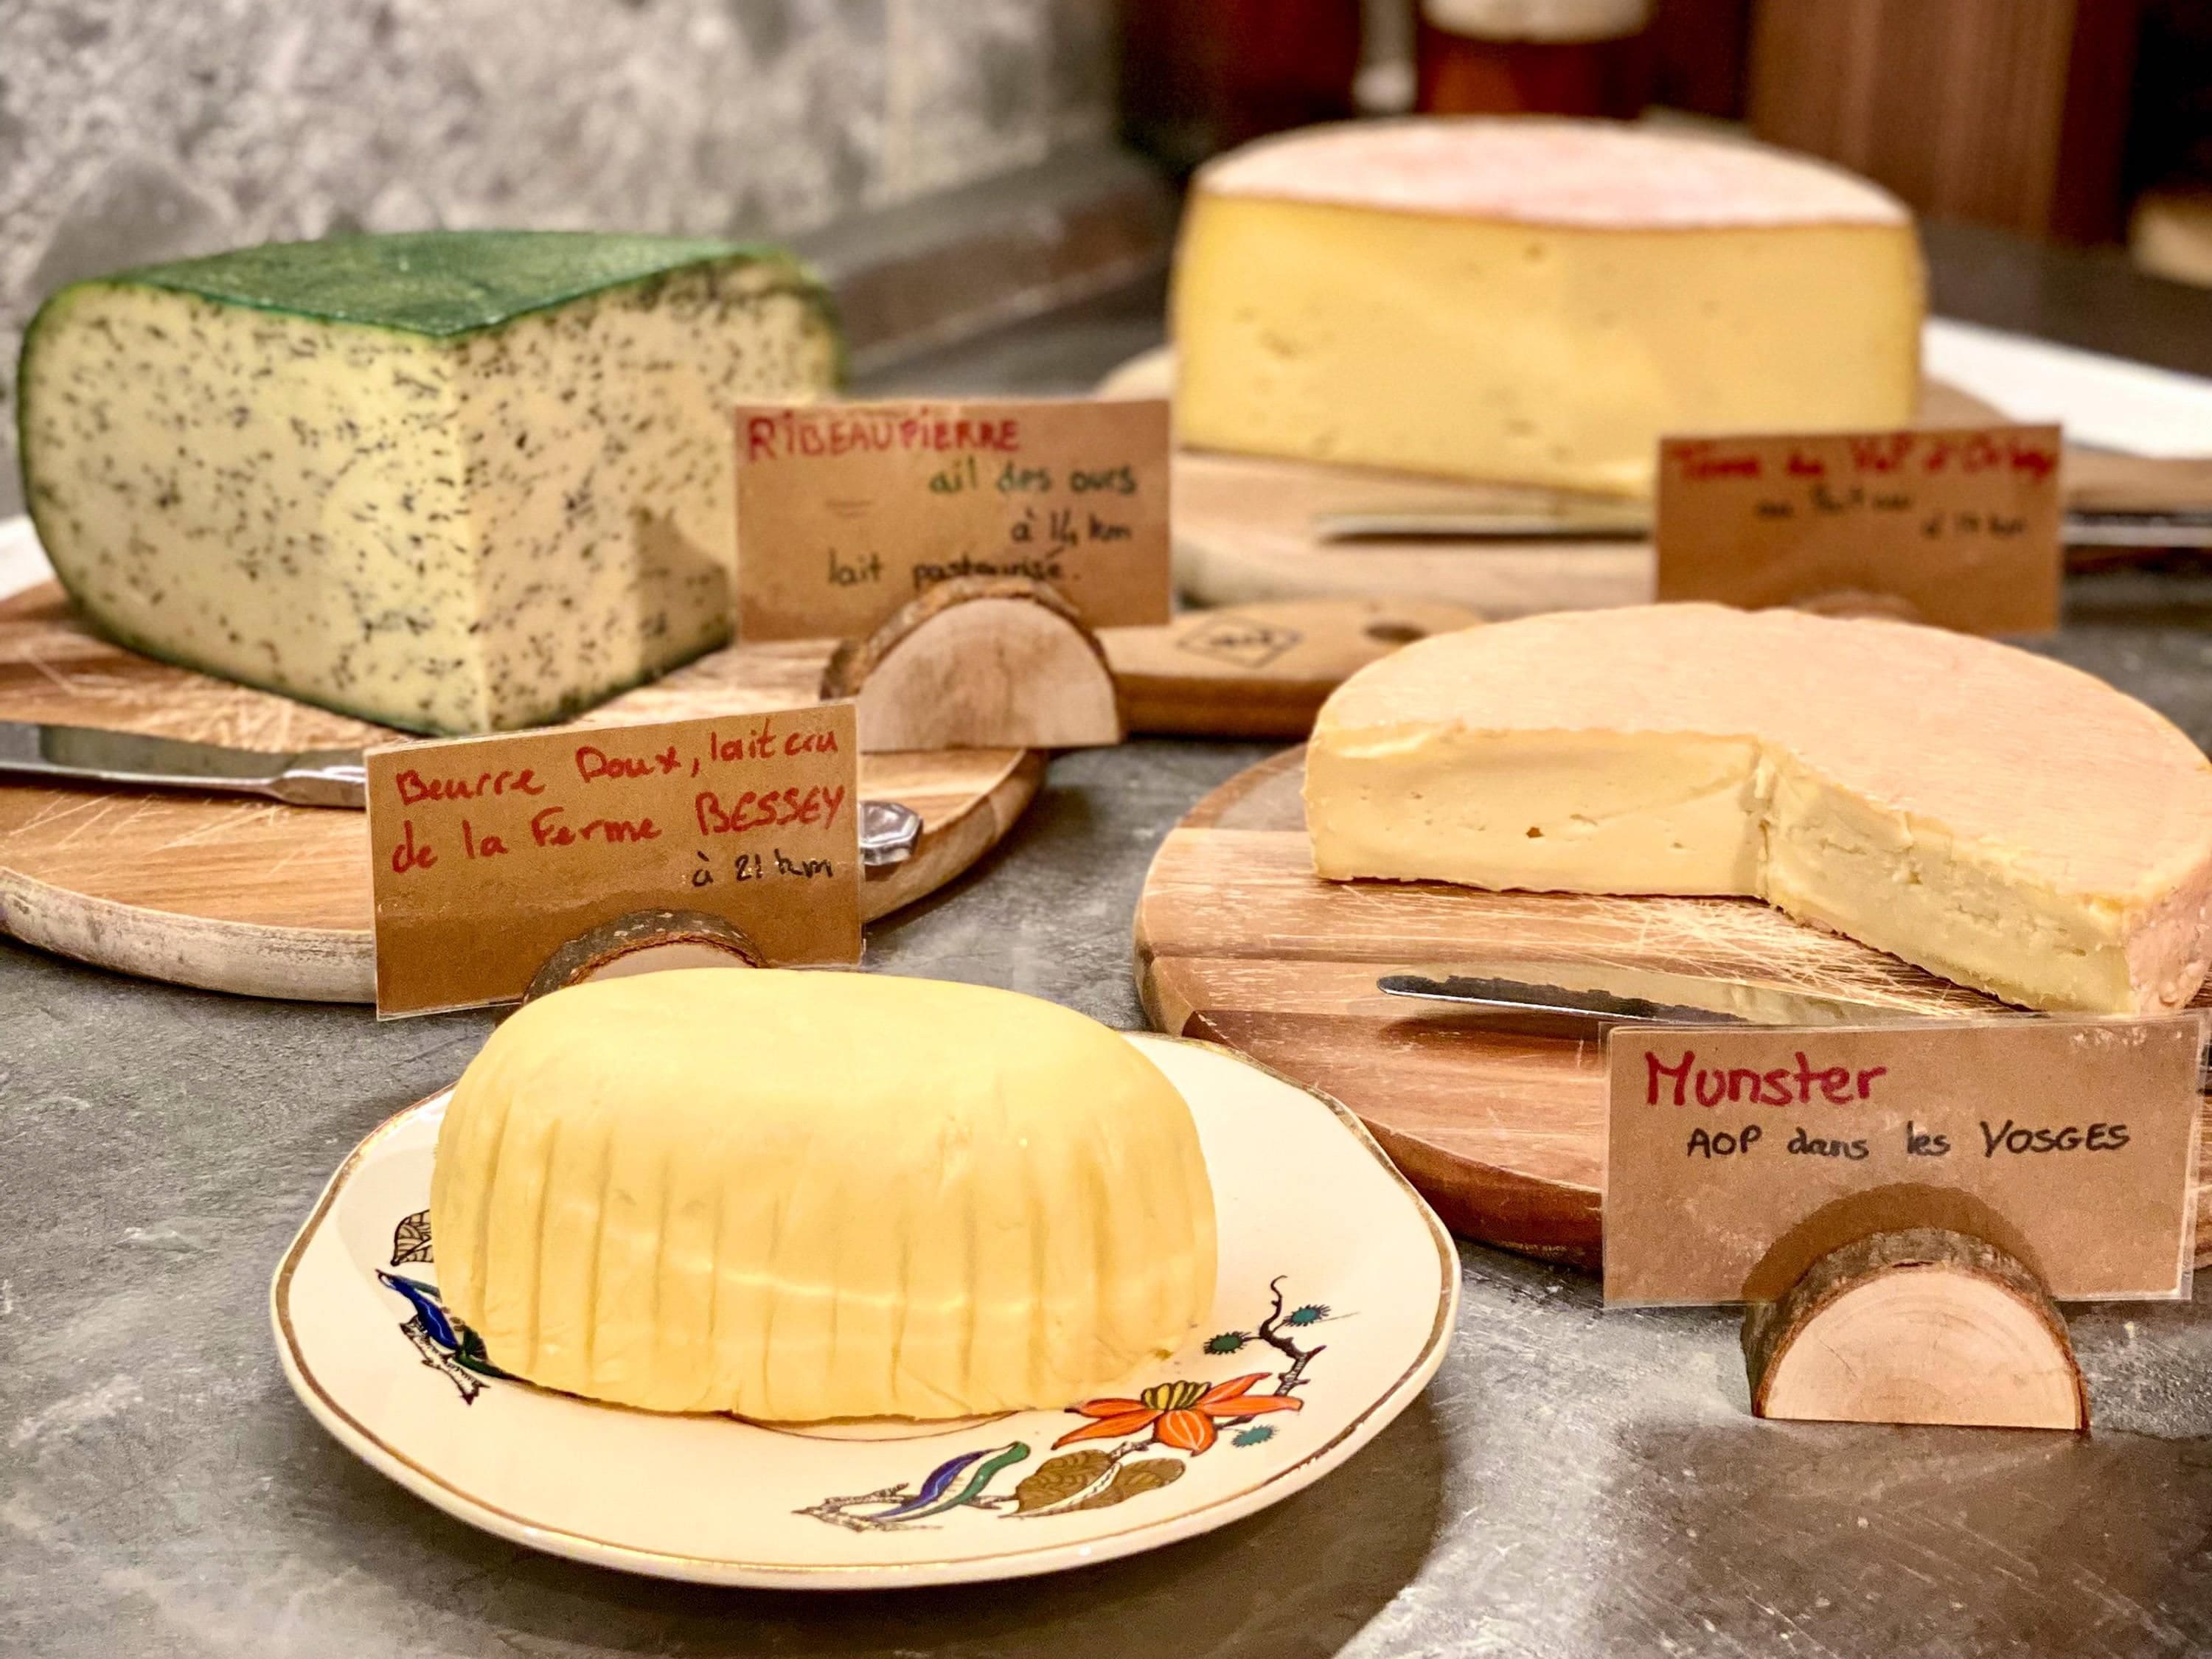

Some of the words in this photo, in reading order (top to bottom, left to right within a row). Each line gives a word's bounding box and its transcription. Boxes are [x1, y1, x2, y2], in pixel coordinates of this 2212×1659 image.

[928, 455, 977, 494] ail
[998, 460, 1051, 493] des
[1068, 463, 1138, 495] ours
[1010, 507, 1035, 543] à
[1088, 512, 1133, 543] km
[827, 547, 883, 588] lait
[395, 768, 546, 806] Beurre
[575, 745, 700, 783] Doux,
[710, 717, 776, 761] lait
[784, 730, 838, 757] cru
[392, 819, 439, 874] de
[462, 819, 509, 860] la
[530, 806, 663, 848] Ferme
[695, 783, 846, 837] BESSEY
[692, 850, 714, 888] à
[734, 853, 764, 883] 21
[1644, 1050, 1888, 1107] Munster
[1686, 1124, 1763, 1159] AOP
[1787, 1125, 1870, 1161] dans
[1907, 1120, 1951, 1157] les
[1979, 1119, 2131, 1159] VOSGES
